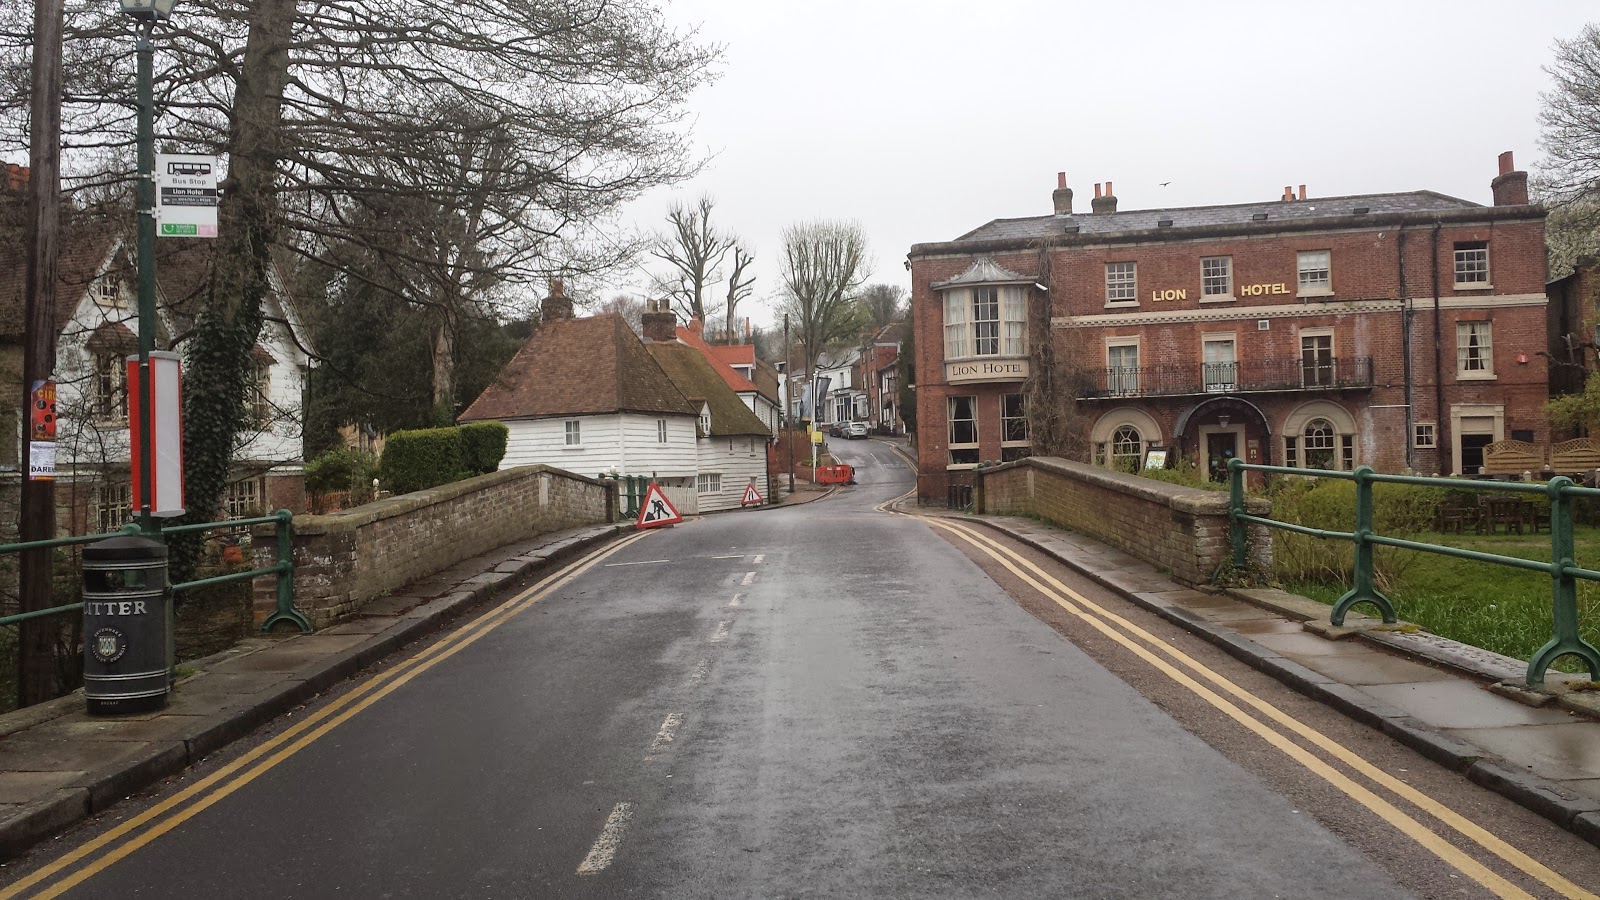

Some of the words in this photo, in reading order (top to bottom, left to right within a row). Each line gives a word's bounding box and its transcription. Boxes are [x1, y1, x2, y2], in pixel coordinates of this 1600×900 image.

[189, 178, 206, 186] Stop
[1152, 289, 1187, 301] LION
[1241, 283, 1291, 296] HOTEL
[83, 600, 147, 616] LITTER
